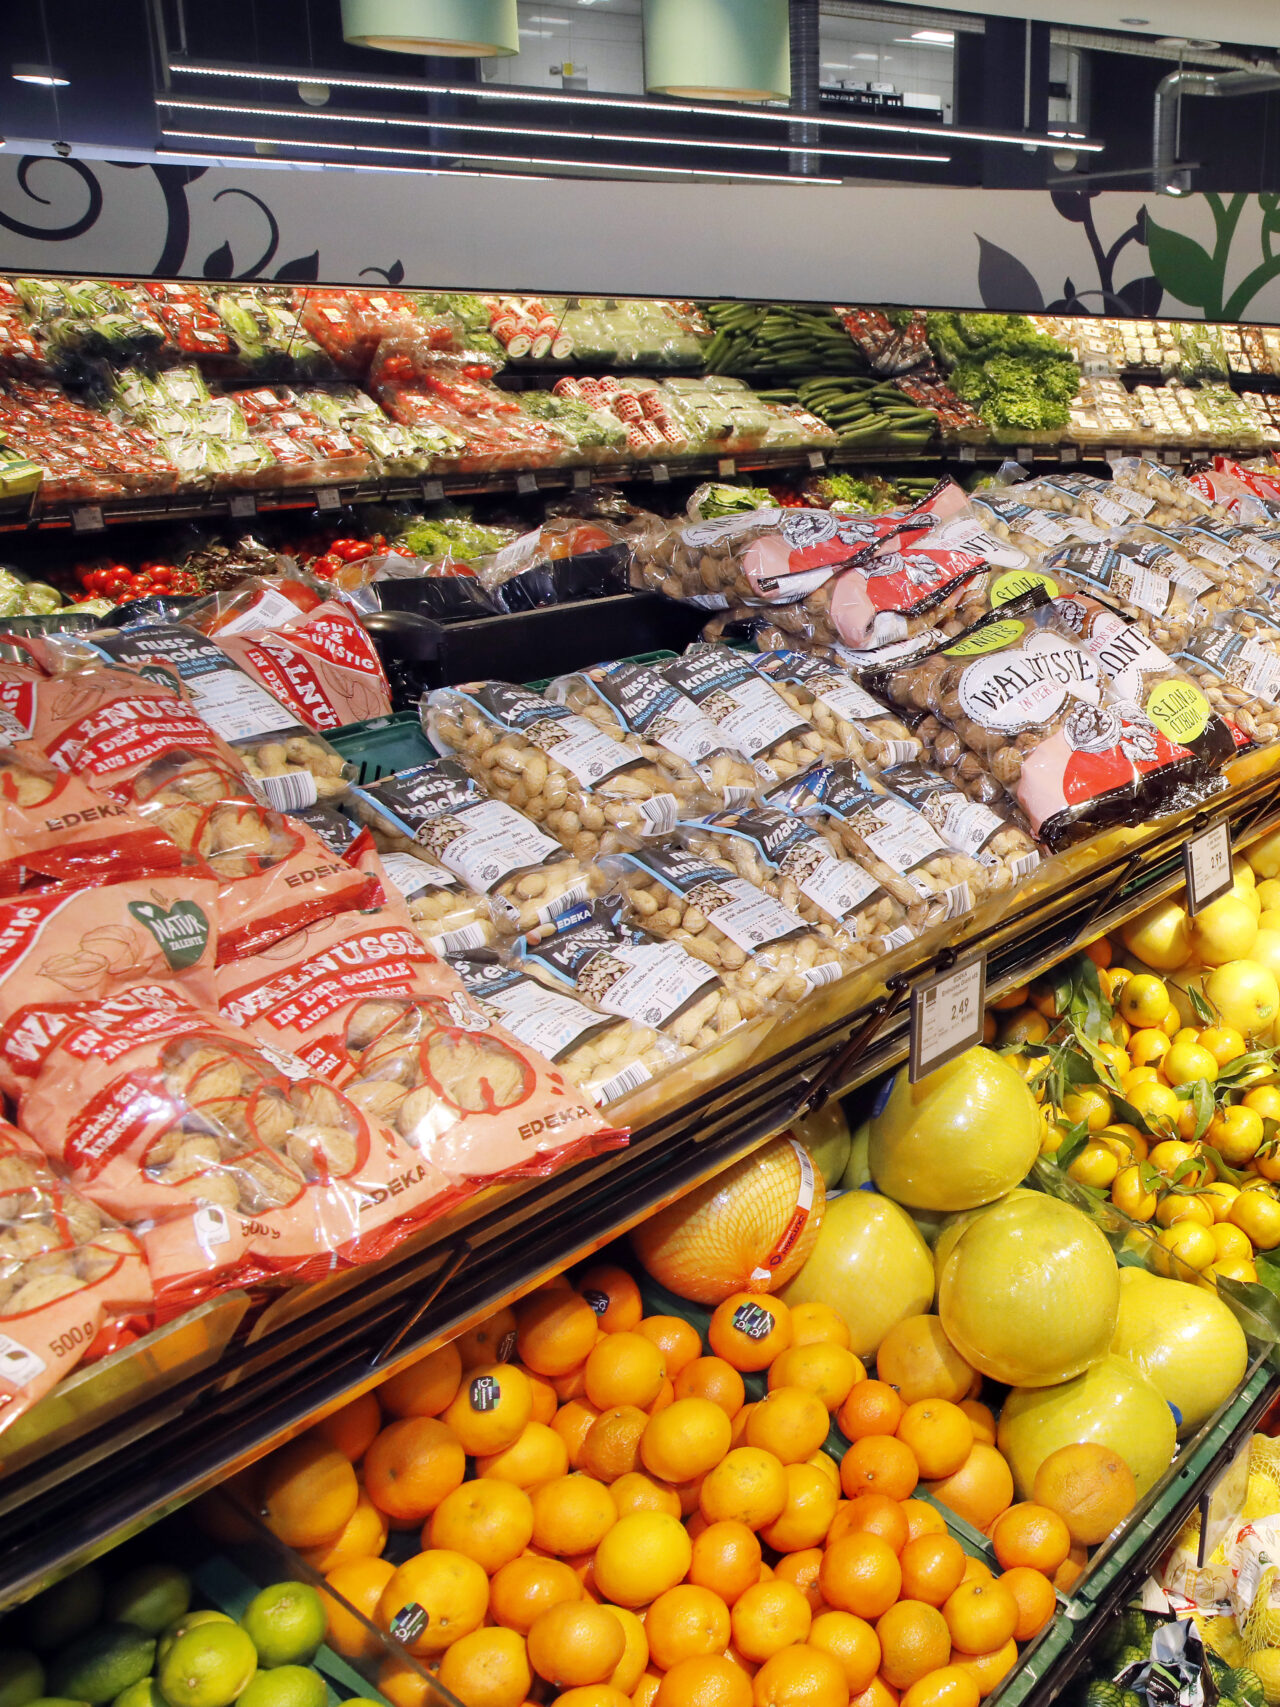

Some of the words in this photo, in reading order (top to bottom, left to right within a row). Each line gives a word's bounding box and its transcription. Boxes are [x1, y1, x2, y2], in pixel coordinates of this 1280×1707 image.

[315, 621, 354, 636] GUT
[328, 632, 343, 644] &
[974, 626, 1019, 651] NUTS
[136, 637, 195, 651] nuss-
[677, 657, 746, 692] knacker
[686, 651, 726, 672] nuss-
[247, 651, 263, 669] IN
[263, 671, 290, 701] DER
[258, 642, 337, 729] ALNÜ
[970, 648, 1095, 713] WALNÜSSE
[620, 678, 673, 719] knacke
[1152, 688, 1187, 723] NUTS
[140, 720, 211, 736] SCHAL
[1169, 711, 1204, 735] WORLD
[94, 751, 127, 773] AUS
[395, 786, 481, 816] knacke
[45, 803, 130, 833] EDEKA
[284, 862, 351, 889] EDEK
[149, 913, 207, 943] NATUR
[556, 906, 593, 930] EDEKA
[219, 930, 426, 1027] WALNÜSSE
[273, 1005, 301, 1026] IN
[302, 980, 342, 1008] DER
[341, 960, 411, 987] SCHALE
[299, 1005, 330, 1030] AUS
[951, 996, 969, 1021] 2.49
[70, 1028, 104, 1055] IN
[517, 1104, 593, 1142] EDEKA
[48, 1320, 94, 1359] 500g
